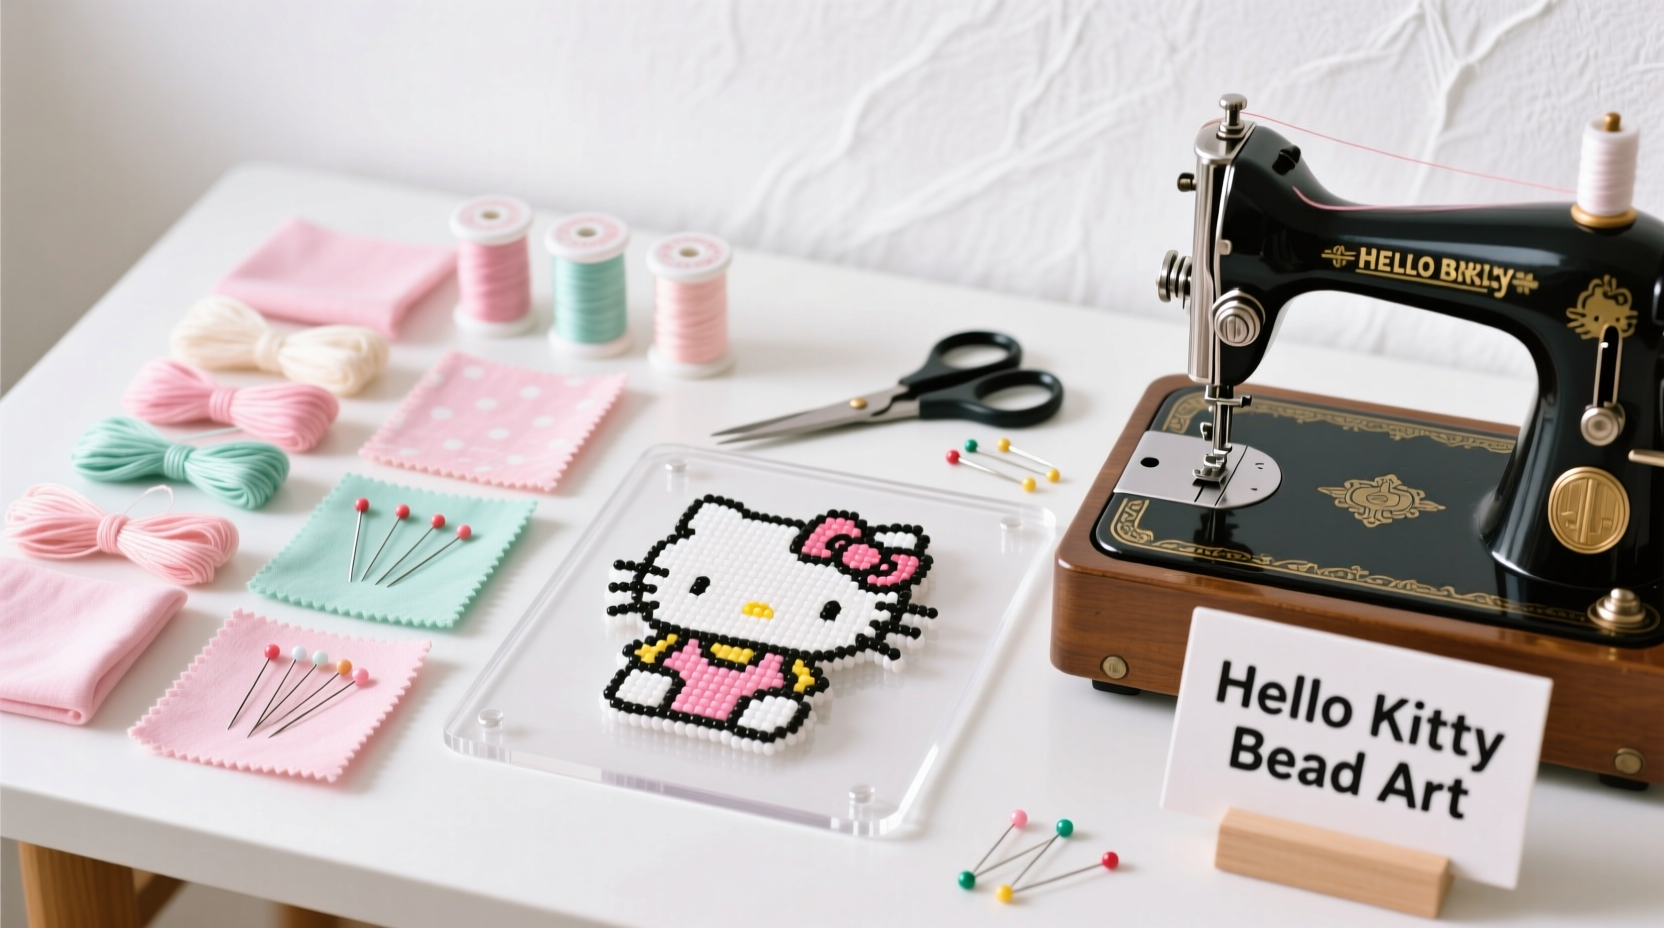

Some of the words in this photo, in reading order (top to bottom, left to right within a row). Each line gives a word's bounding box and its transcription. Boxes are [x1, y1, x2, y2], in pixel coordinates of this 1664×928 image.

[1358, 247, 1435, 278] HELLO
[1216, 660, 1353, 729] Hello
[1370, 693, 1505, 773] Kitty
[1229, 726, 1366, 796] Bead
[1377, 761, 1469, 820] Art
